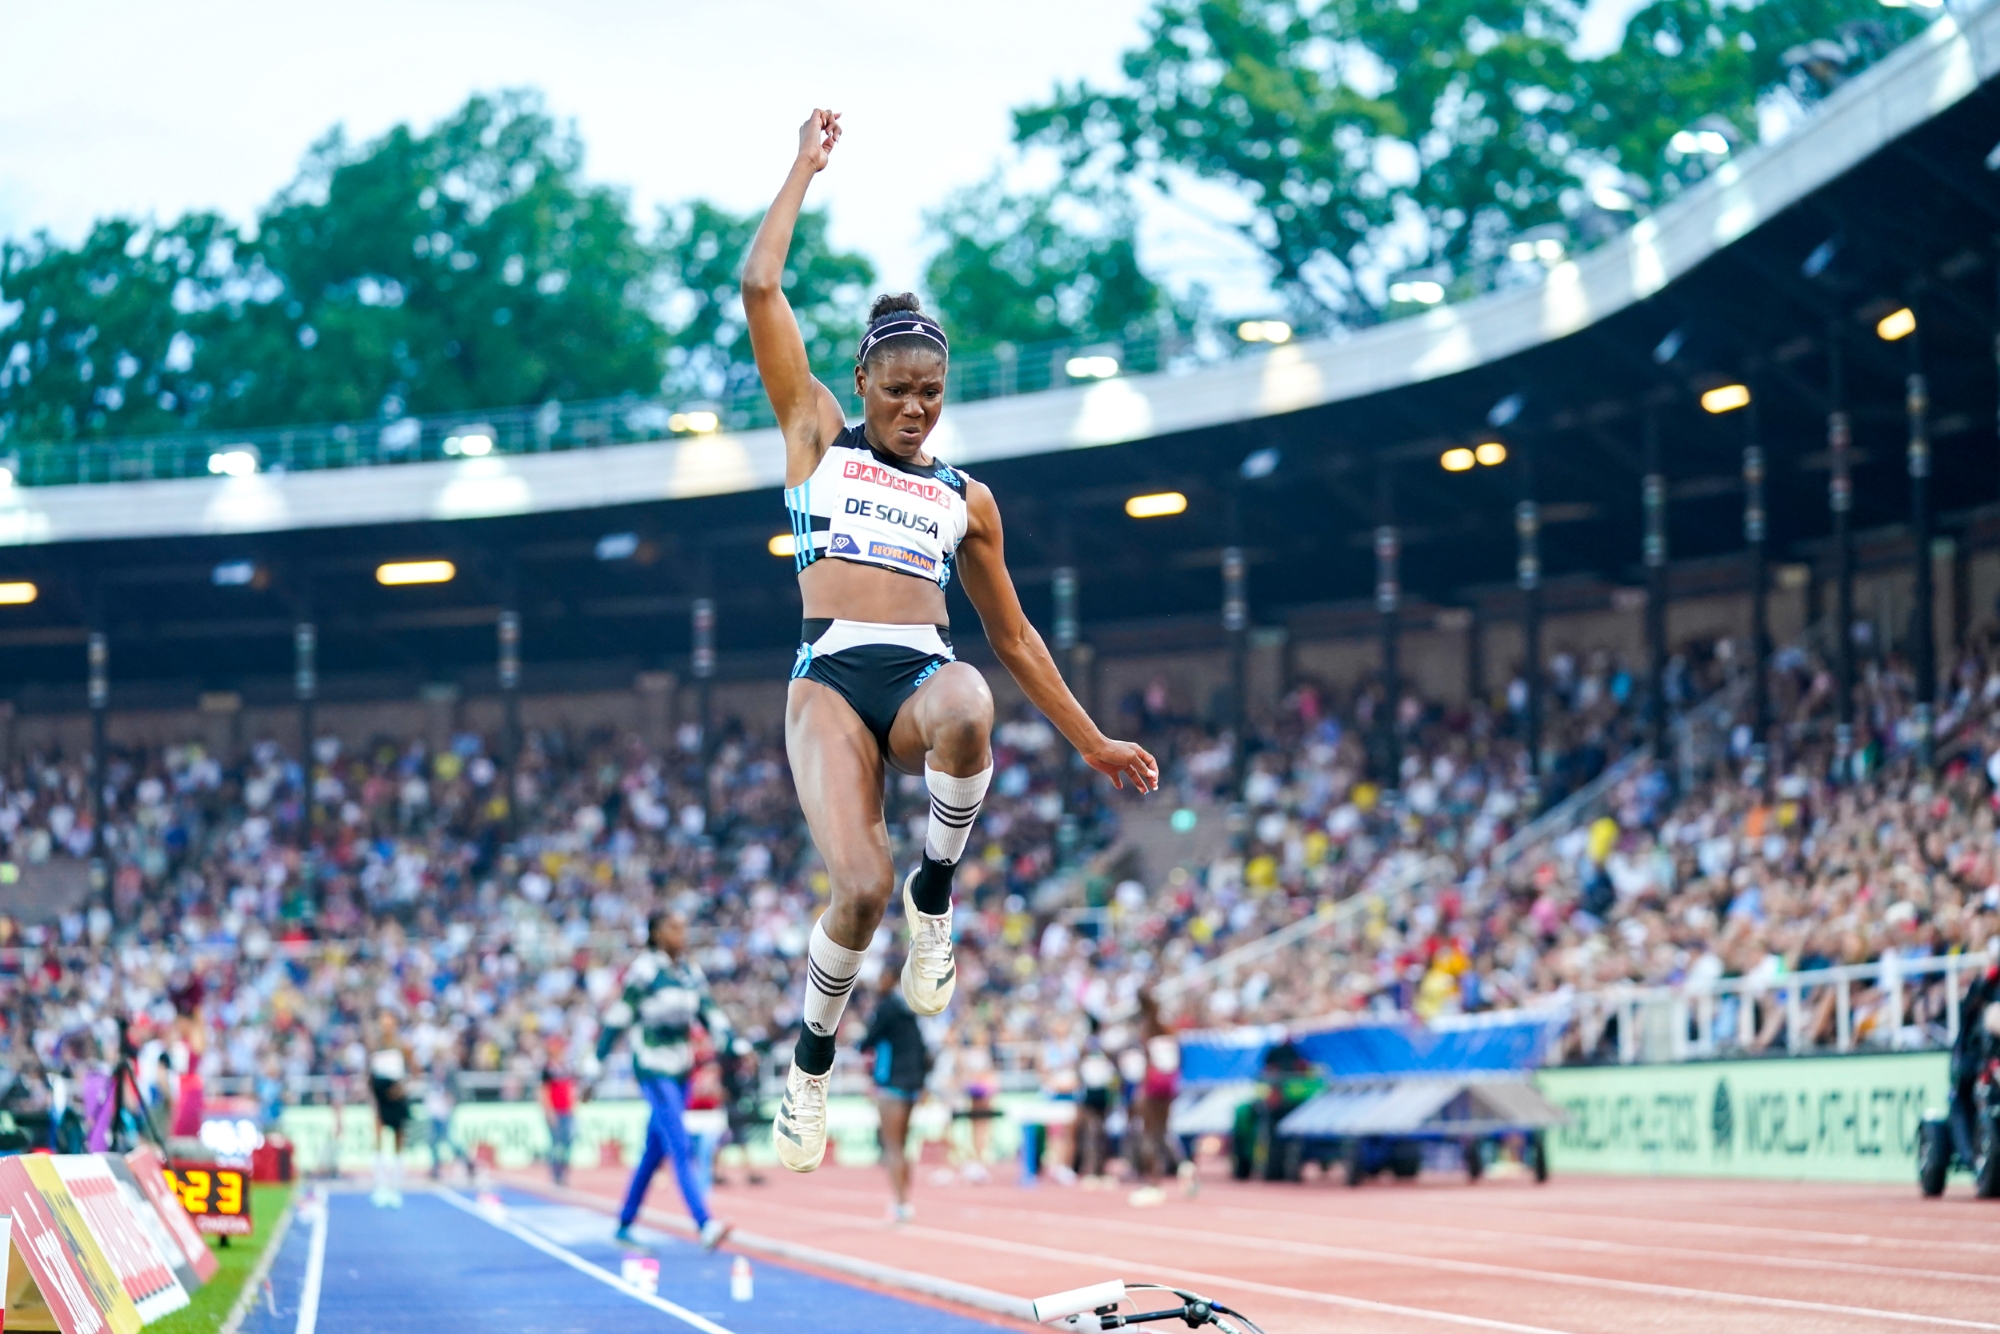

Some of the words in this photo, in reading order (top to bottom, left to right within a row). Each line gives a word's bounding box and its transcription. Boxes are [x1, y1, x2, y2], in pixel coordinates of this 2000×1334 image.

[844, 462, 950, 509] BAUHAUS
[845, 498, 873, 517] DE
[875, 504, 938, 540] SOUSA
